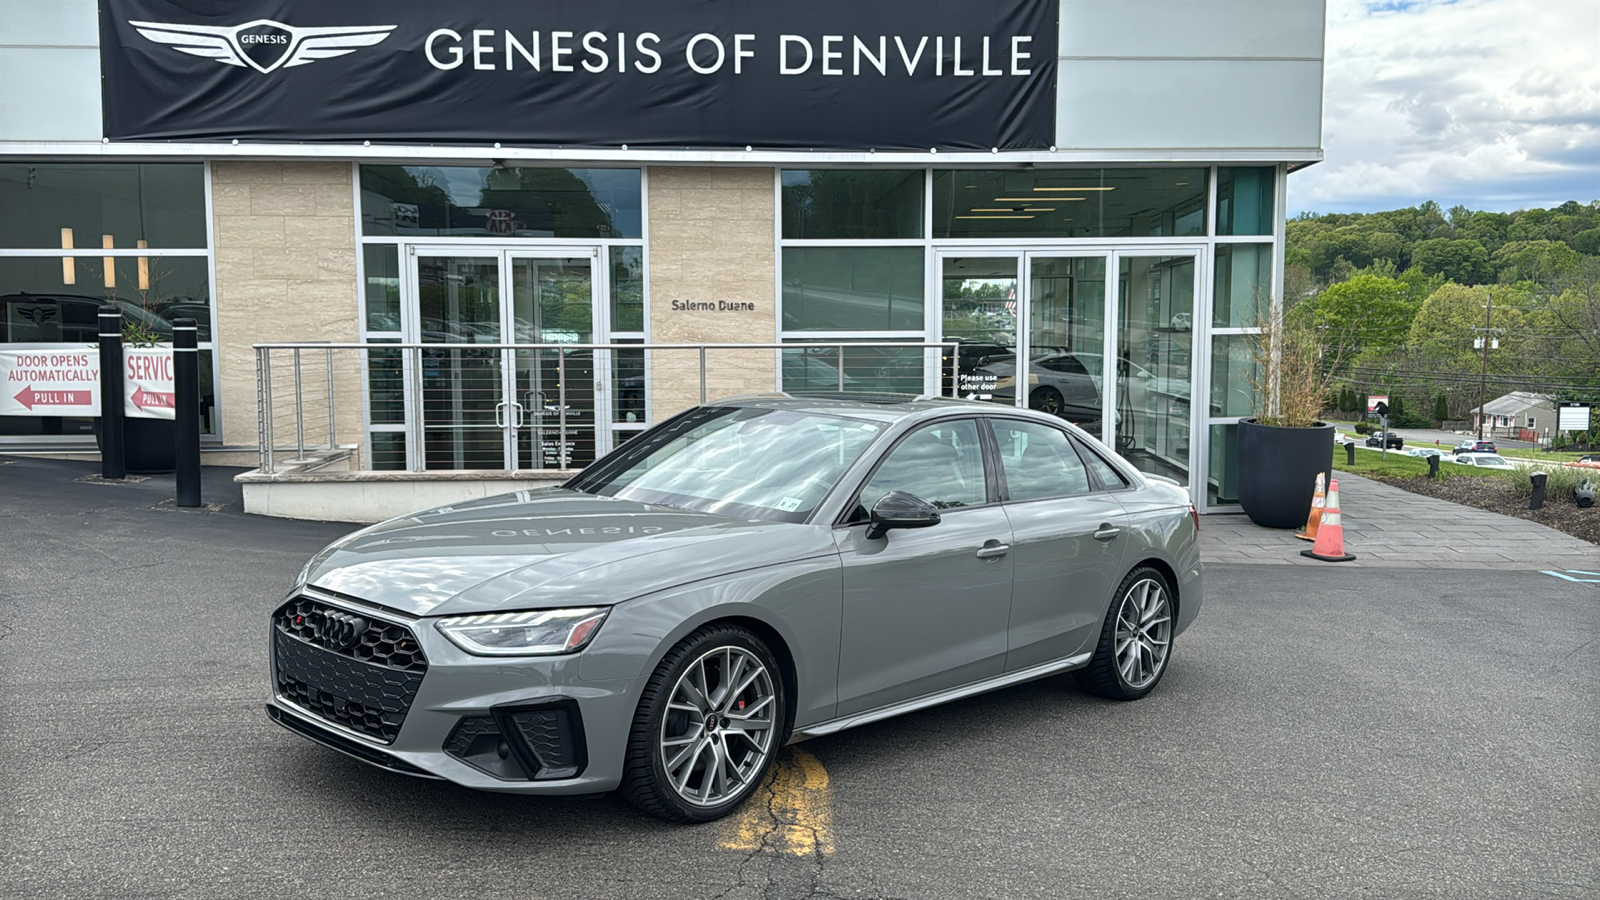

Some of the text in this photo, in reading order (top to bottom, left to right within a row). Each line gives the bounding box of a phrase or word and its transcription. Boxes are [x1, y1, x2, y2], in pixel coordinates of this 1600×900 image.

[241, 34, 287, 44] GENESIS
[424, 28, 1033, 77] GENESIS OF DENVILLE
[671, 299, 755, 311] Salerno Duane
[17, 355, 88, 367] DOOR OPENS
[128, 355, 173, 381] SERVIC
[9, 369, 99, 382] AUTOMATICALLY
[34, 393, 74, 403] PULL IN
[142, 394, 158, 404] PULL
